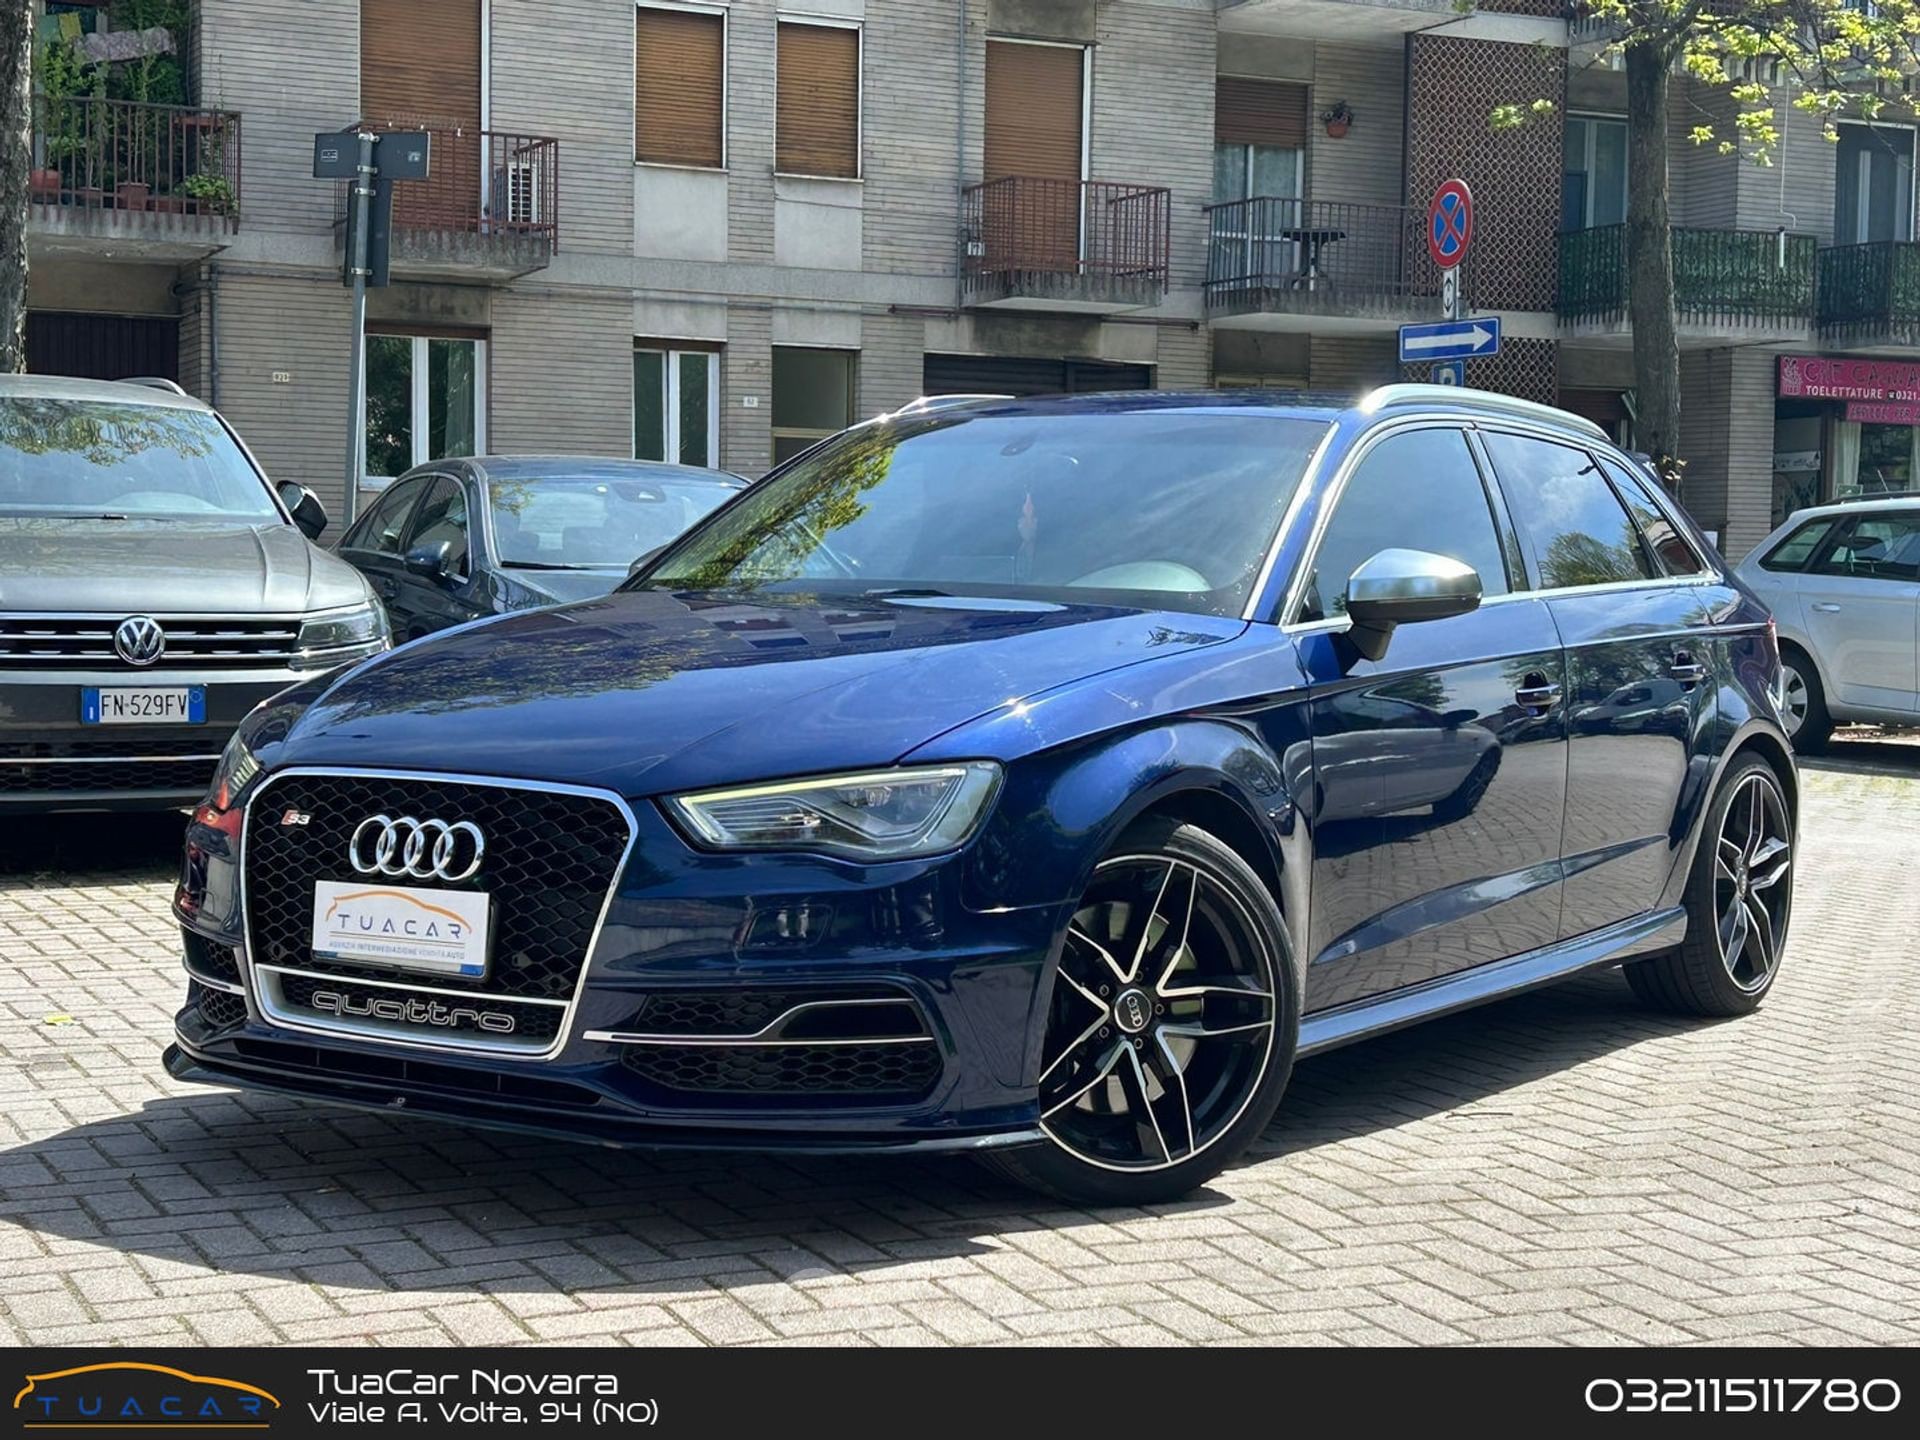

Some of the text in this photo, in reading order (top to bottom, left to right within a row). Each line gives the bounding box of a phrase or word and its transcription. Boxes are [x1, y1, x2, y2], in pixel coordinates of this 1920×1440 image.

[1805, 385, 1884, 400] TOELETTATURE
[338, 913, 462, 939] TUACAR
[311, 990, 515, 1033] quattro
